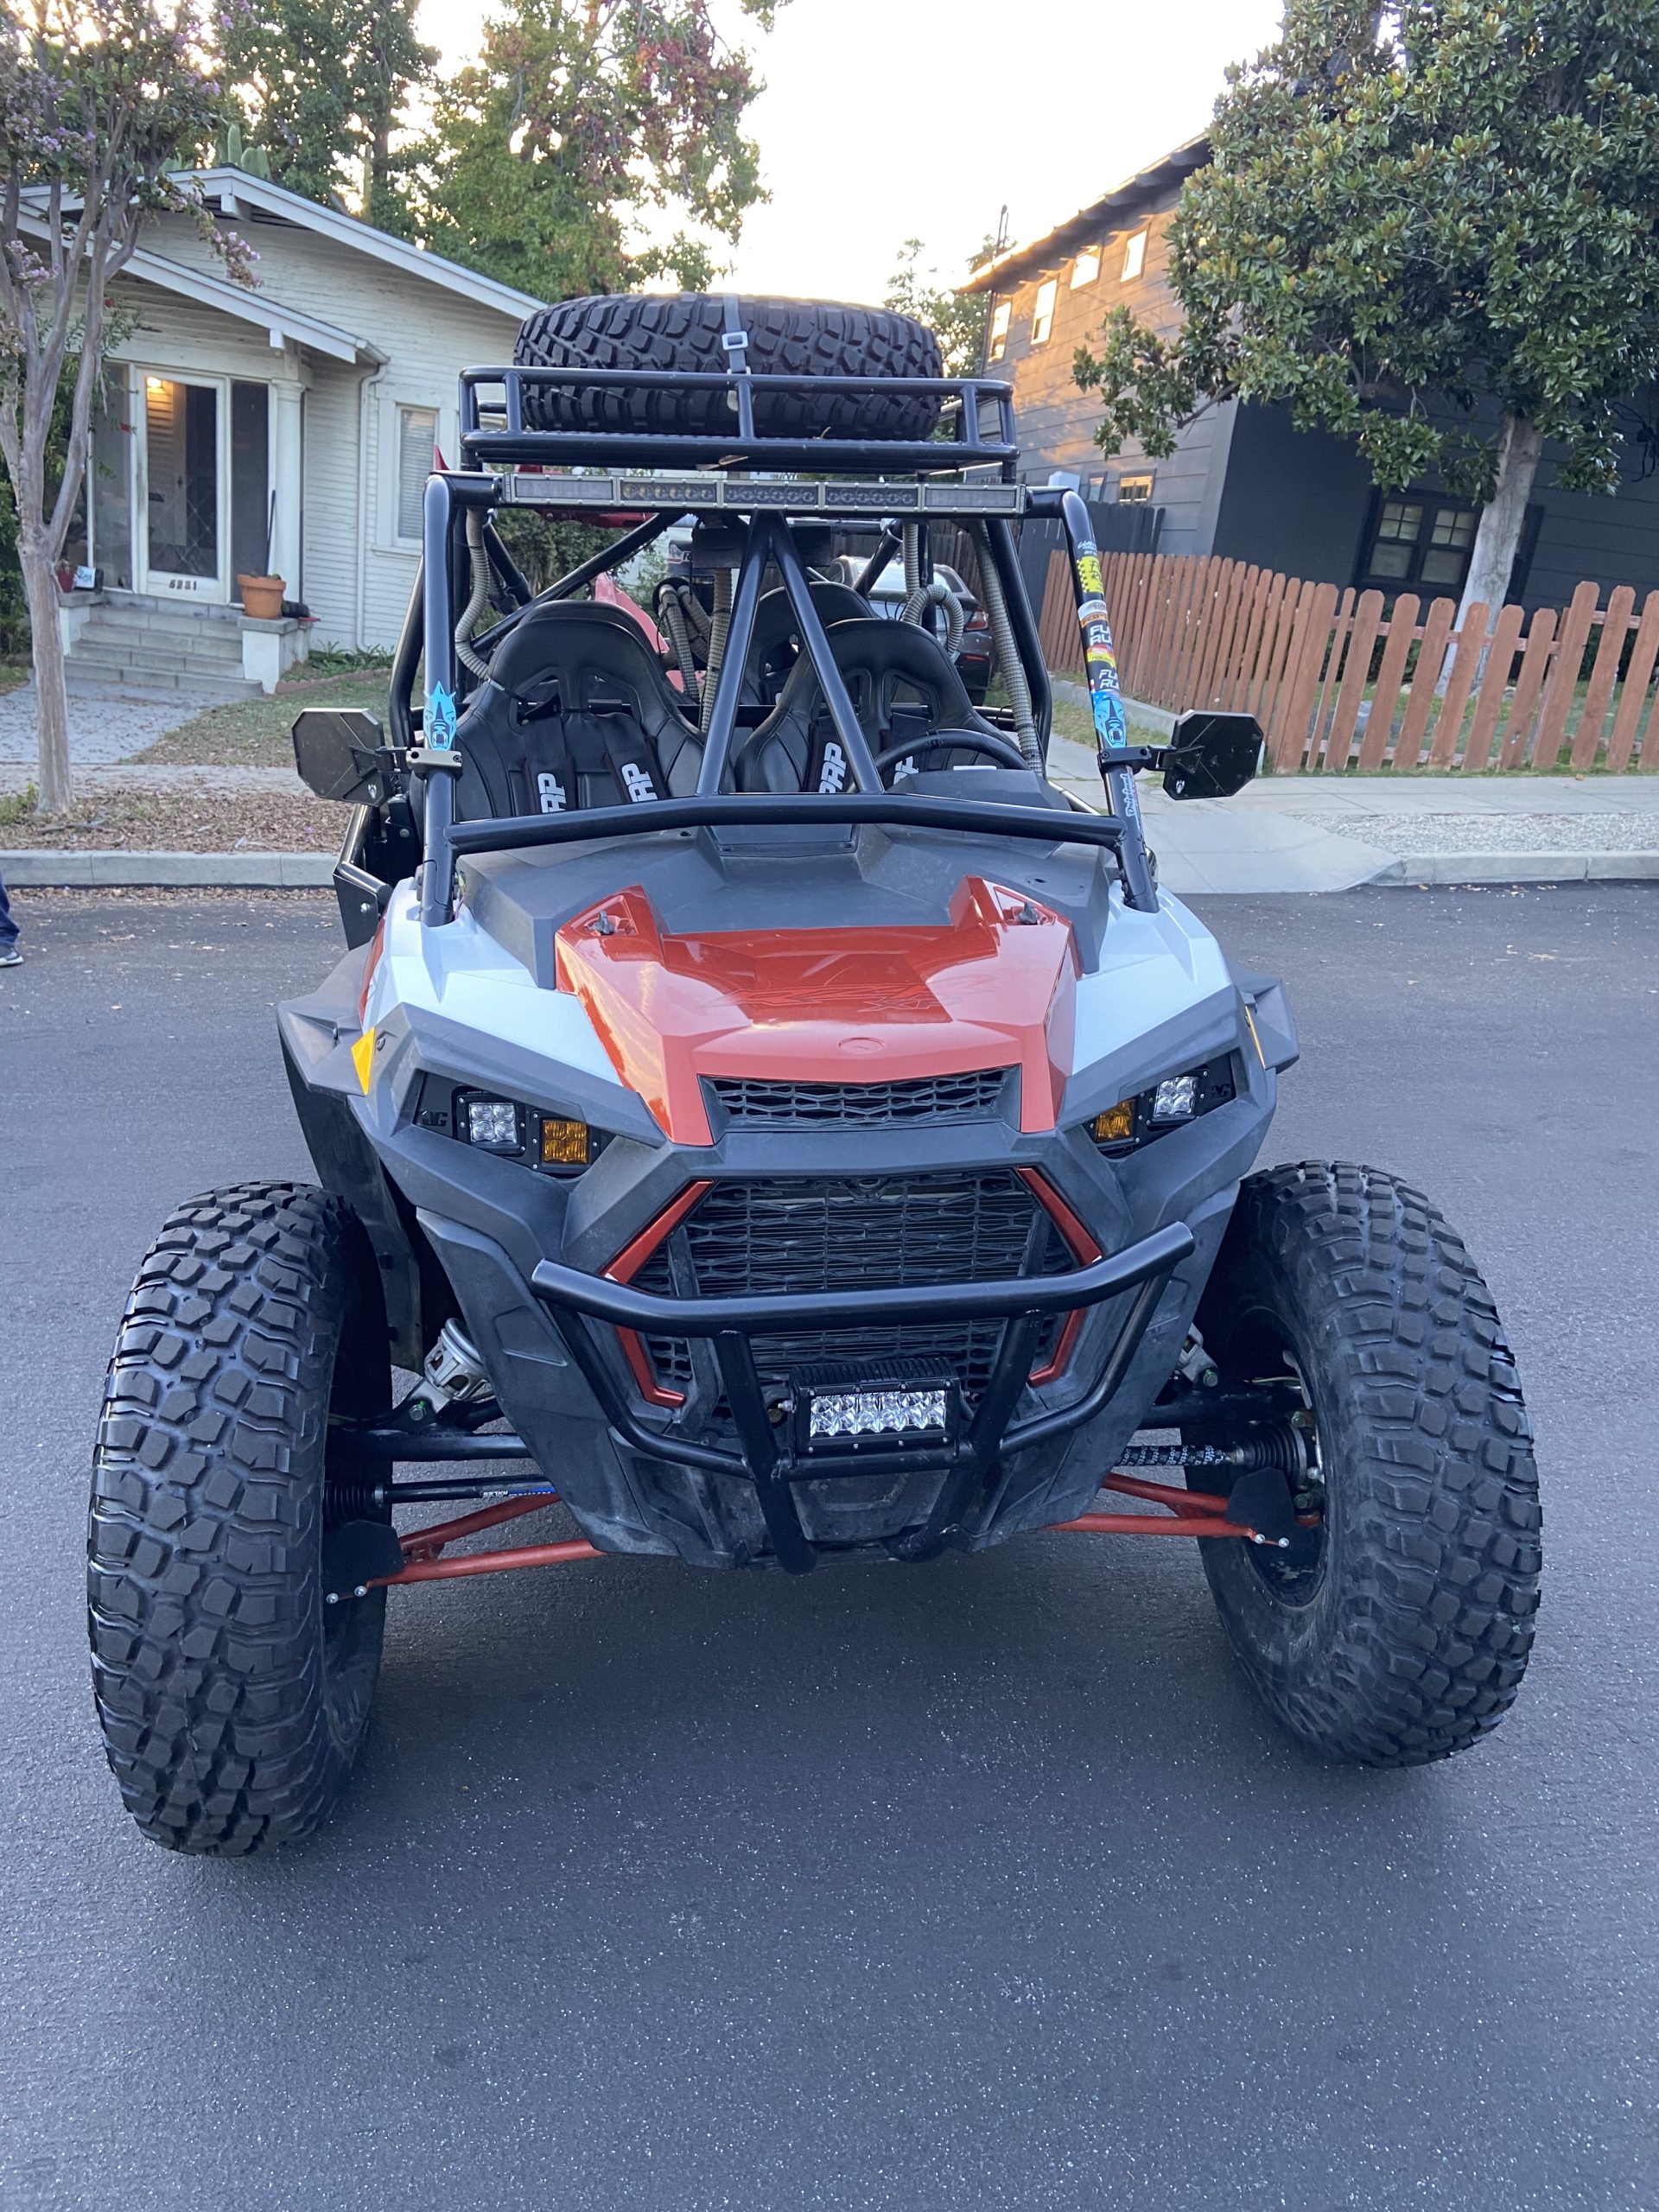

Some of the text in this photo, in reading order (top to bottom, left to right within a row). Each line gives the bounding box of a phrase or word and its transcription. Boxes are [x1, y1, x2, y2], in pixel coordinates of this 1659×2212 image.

[1090, 624, 1110, 636] FU
[1090, 634, 1113, 646] RU
[1098, 669, 1118, 679] FU
[1099, 678, 1120, 690] RU
[621, 763, 658, 803] RP
[537, 772, 567, 813] RP
